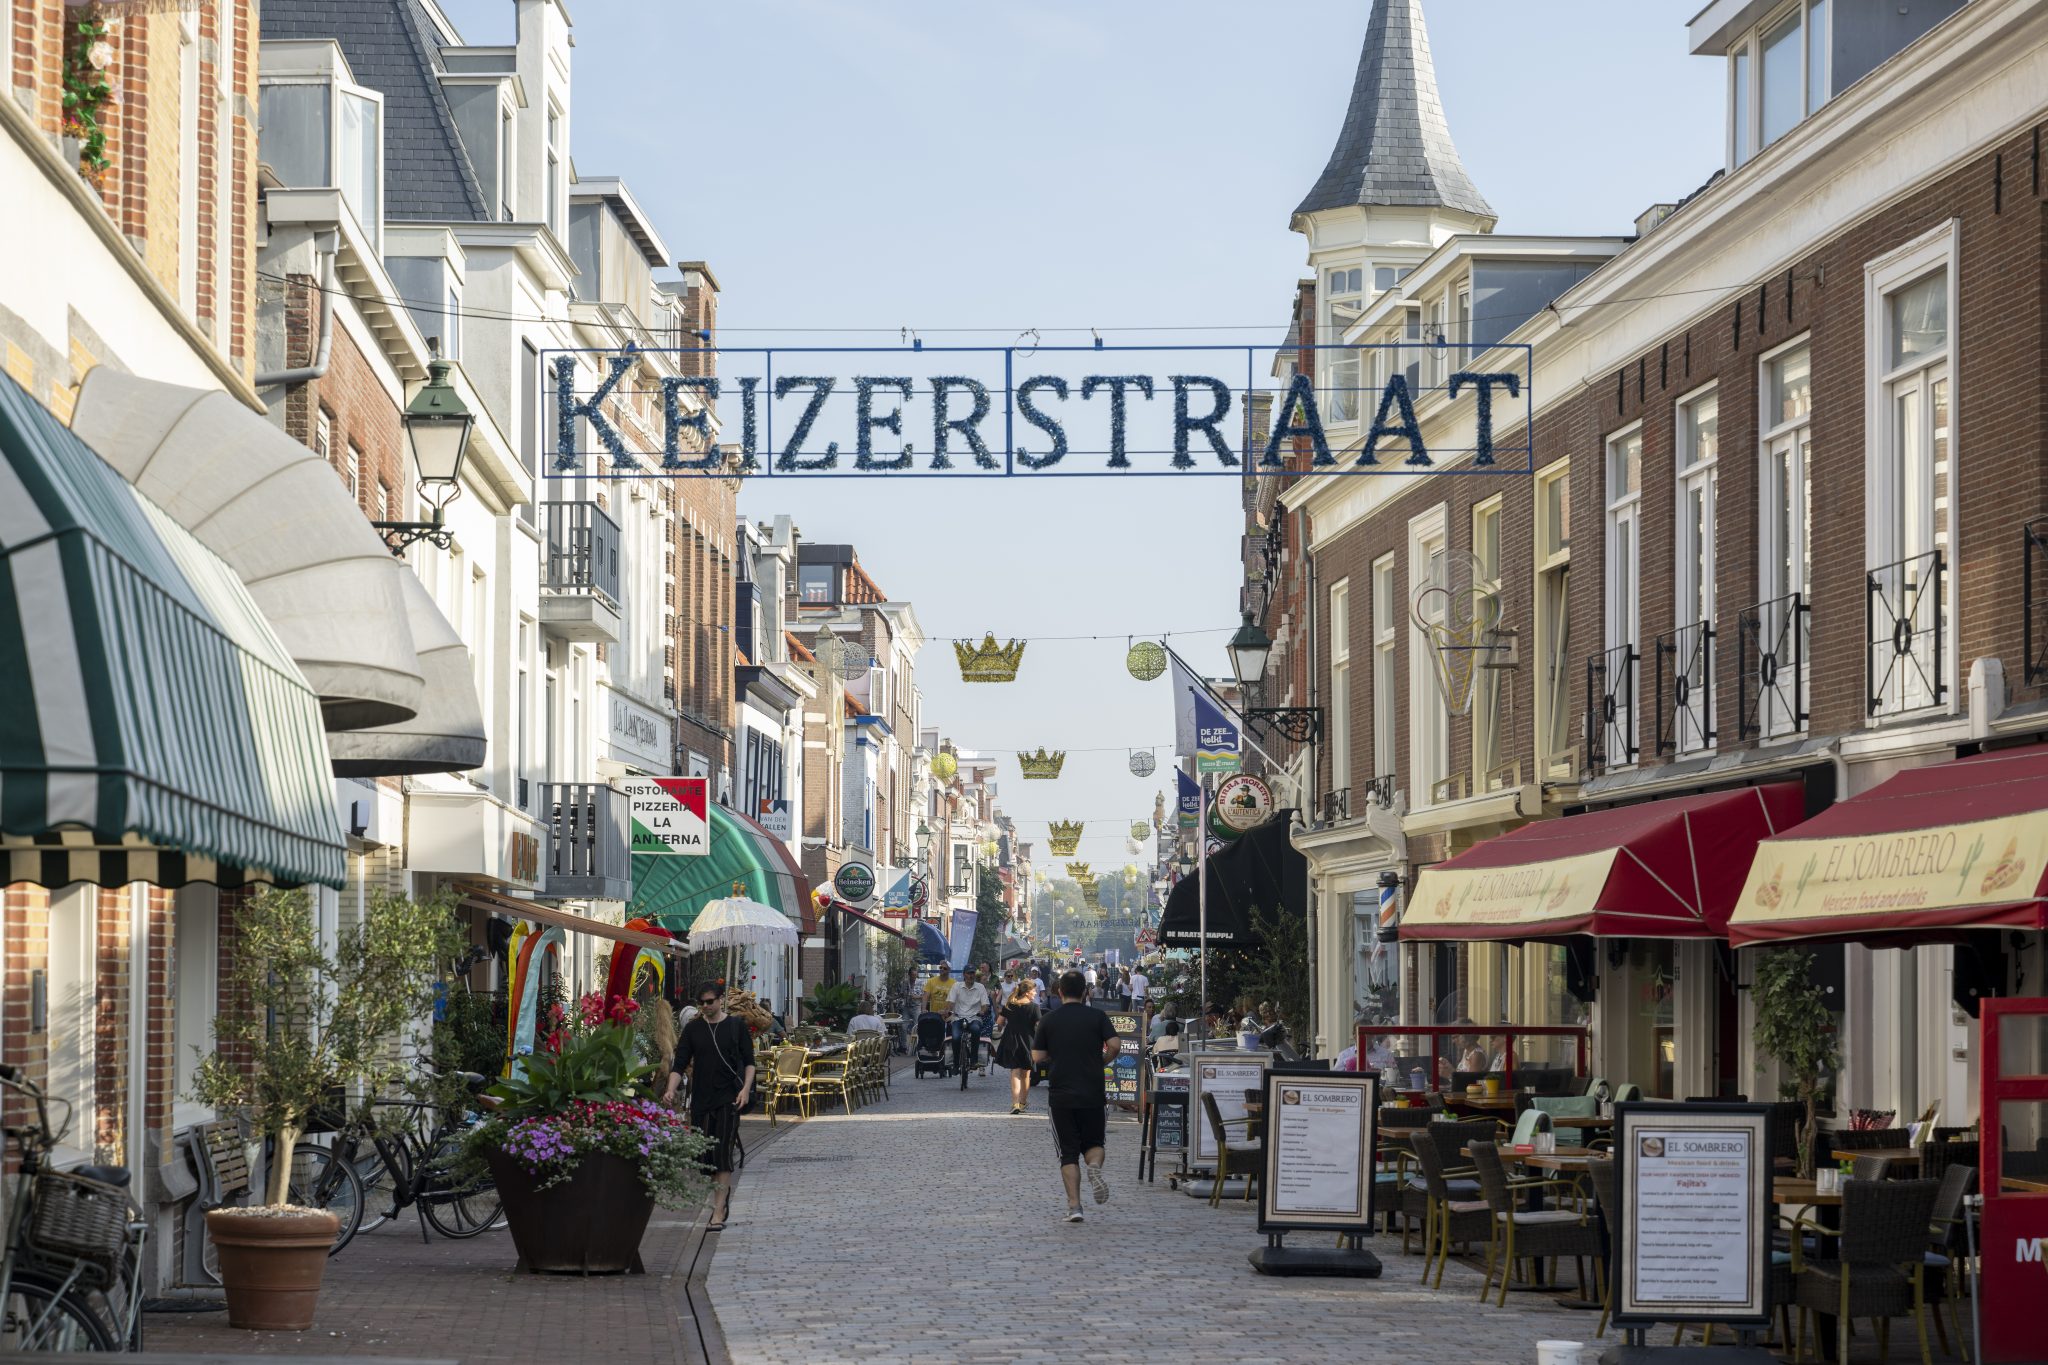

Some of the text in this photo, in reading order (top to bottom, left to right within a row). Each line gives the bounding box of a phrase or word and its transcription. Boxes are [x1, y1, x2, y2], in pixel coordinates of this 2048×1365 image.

[552, 353, 1521, 472] KEIZERSTRAAT
[624, 785, 703, 796] RISTORANTE
[1219, 778, 1270, 806] BIRRA MORETTI
[633, 801, 691, 812] PIZZERIA
[653, 817, 672, 828] LA
[631, 833, 701, 845] ANTERNA
[1822, 831, 1957, 883] EL SOMBRERO
[838, 879, 873, 887] Heineken
[1166, 930, 1234, 939] DE MAATSHAPPIJ
[1302, 1093, 1358, 1104] EL SOMBRERO
[1667, 1142, 1743, 1154] EL SOMBRERO
[1676, 1179, 1708, 1189] Fajita's
